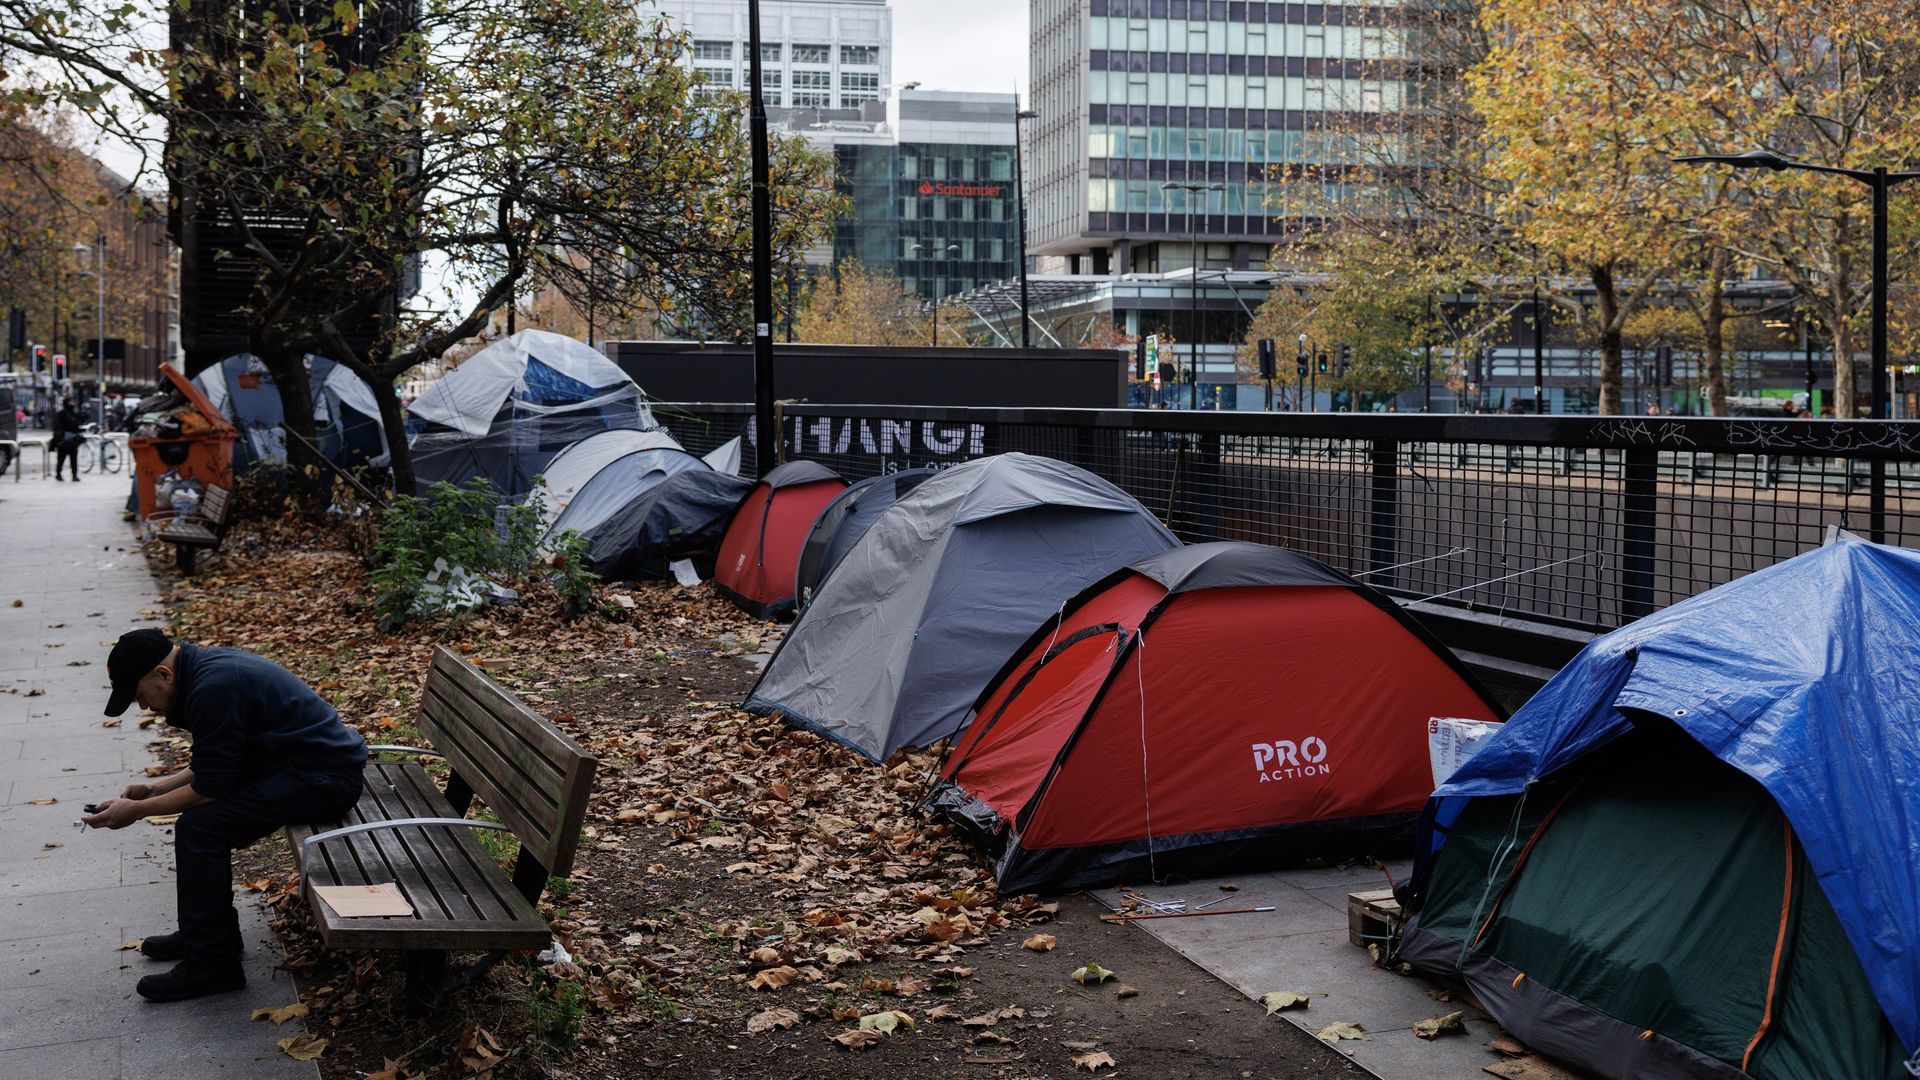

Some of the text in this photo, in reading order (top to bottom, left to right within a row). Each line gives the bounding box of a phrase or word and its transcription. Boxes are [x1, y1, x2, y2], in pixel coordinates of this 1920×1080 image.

[935, 182, 1003, 196] Santander
[1252, 736, 1327, 772] PRO
[1259, 764, 1330, 783] ACTION
